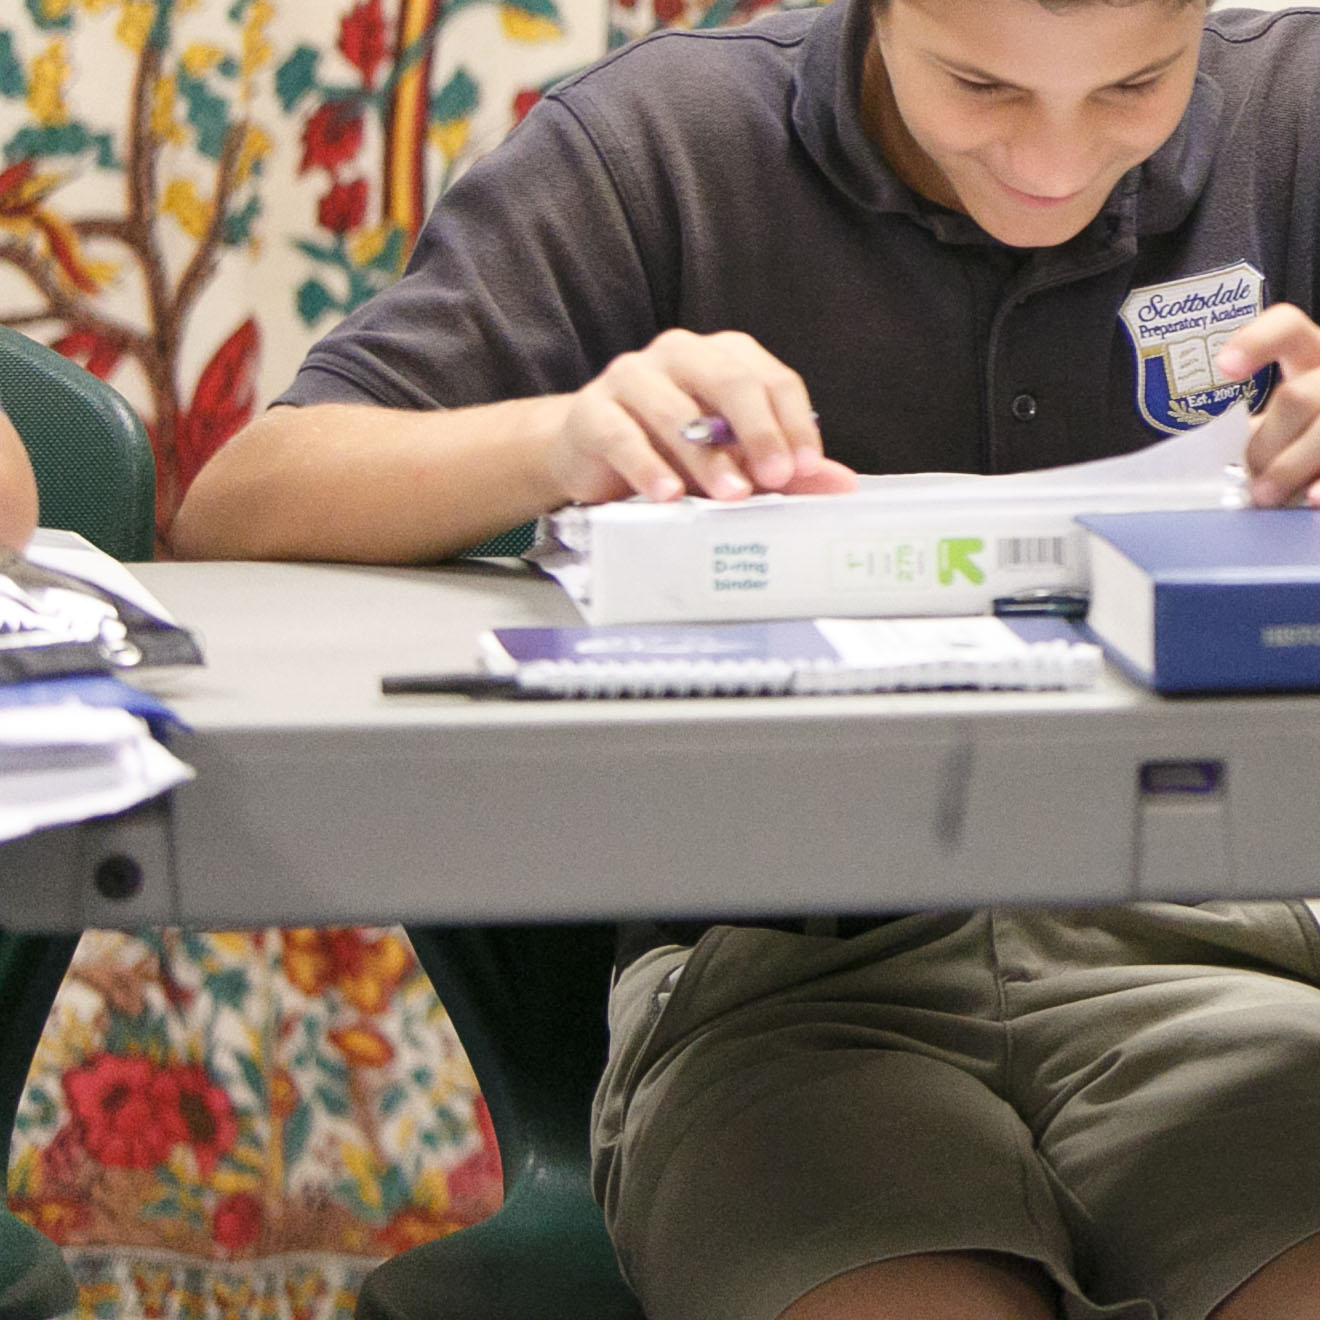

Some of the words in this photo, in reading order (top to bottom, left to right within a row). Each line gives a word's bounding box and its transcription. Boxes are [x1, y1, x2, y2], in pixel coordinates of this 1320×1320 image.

[1138, 278, 1250, 322] Scottsdale
[1138, 316, 1208, 340] Preparatory
[1210, 303, 1258, 325] Academy
[1187, 393, 1212, 408] Est.
[1213, 384, 1241, 403] 2007
[713, 578, 768, 592] binder
